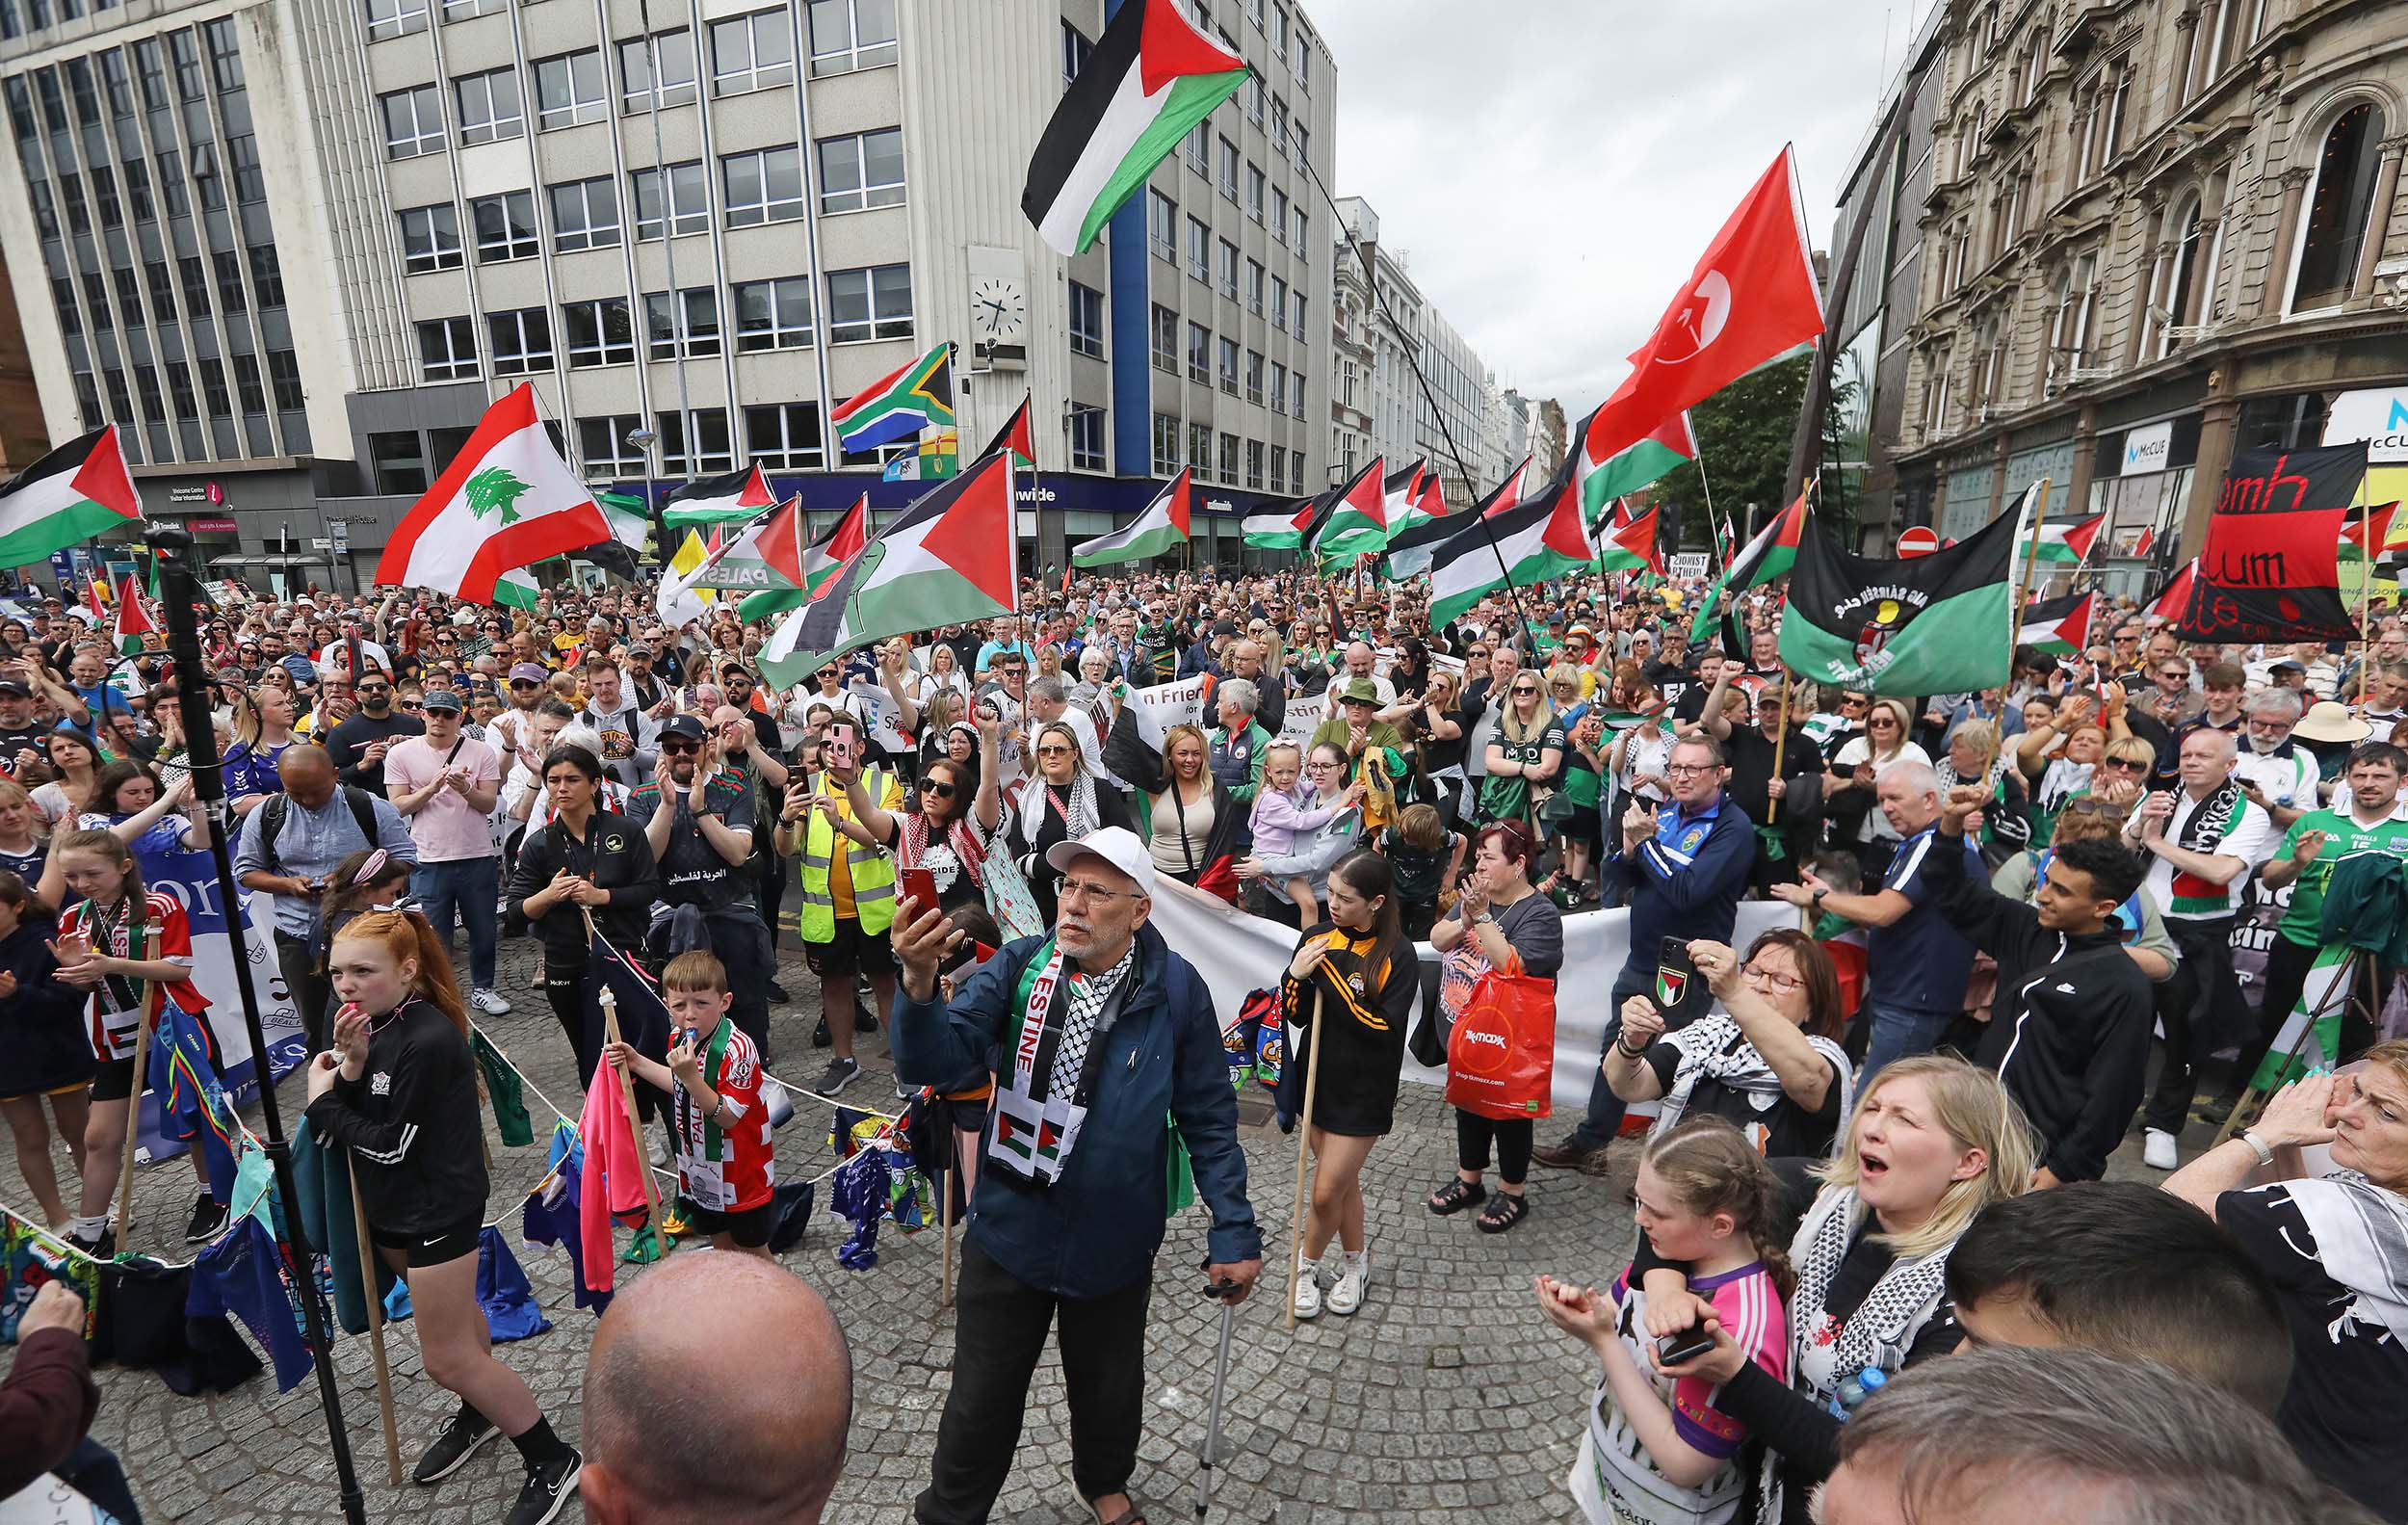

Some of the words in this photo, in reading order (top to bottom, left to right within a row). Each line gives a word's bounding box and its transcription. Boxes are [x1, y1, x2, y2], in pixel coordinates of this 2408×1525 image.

[2139, 439, 2166, 457] McCUE
[1674, 556, 1707, 566] ZIONIST
[1185, 705, 1198, 715] for
[1455, 1071, 1468, 1081] Shop
